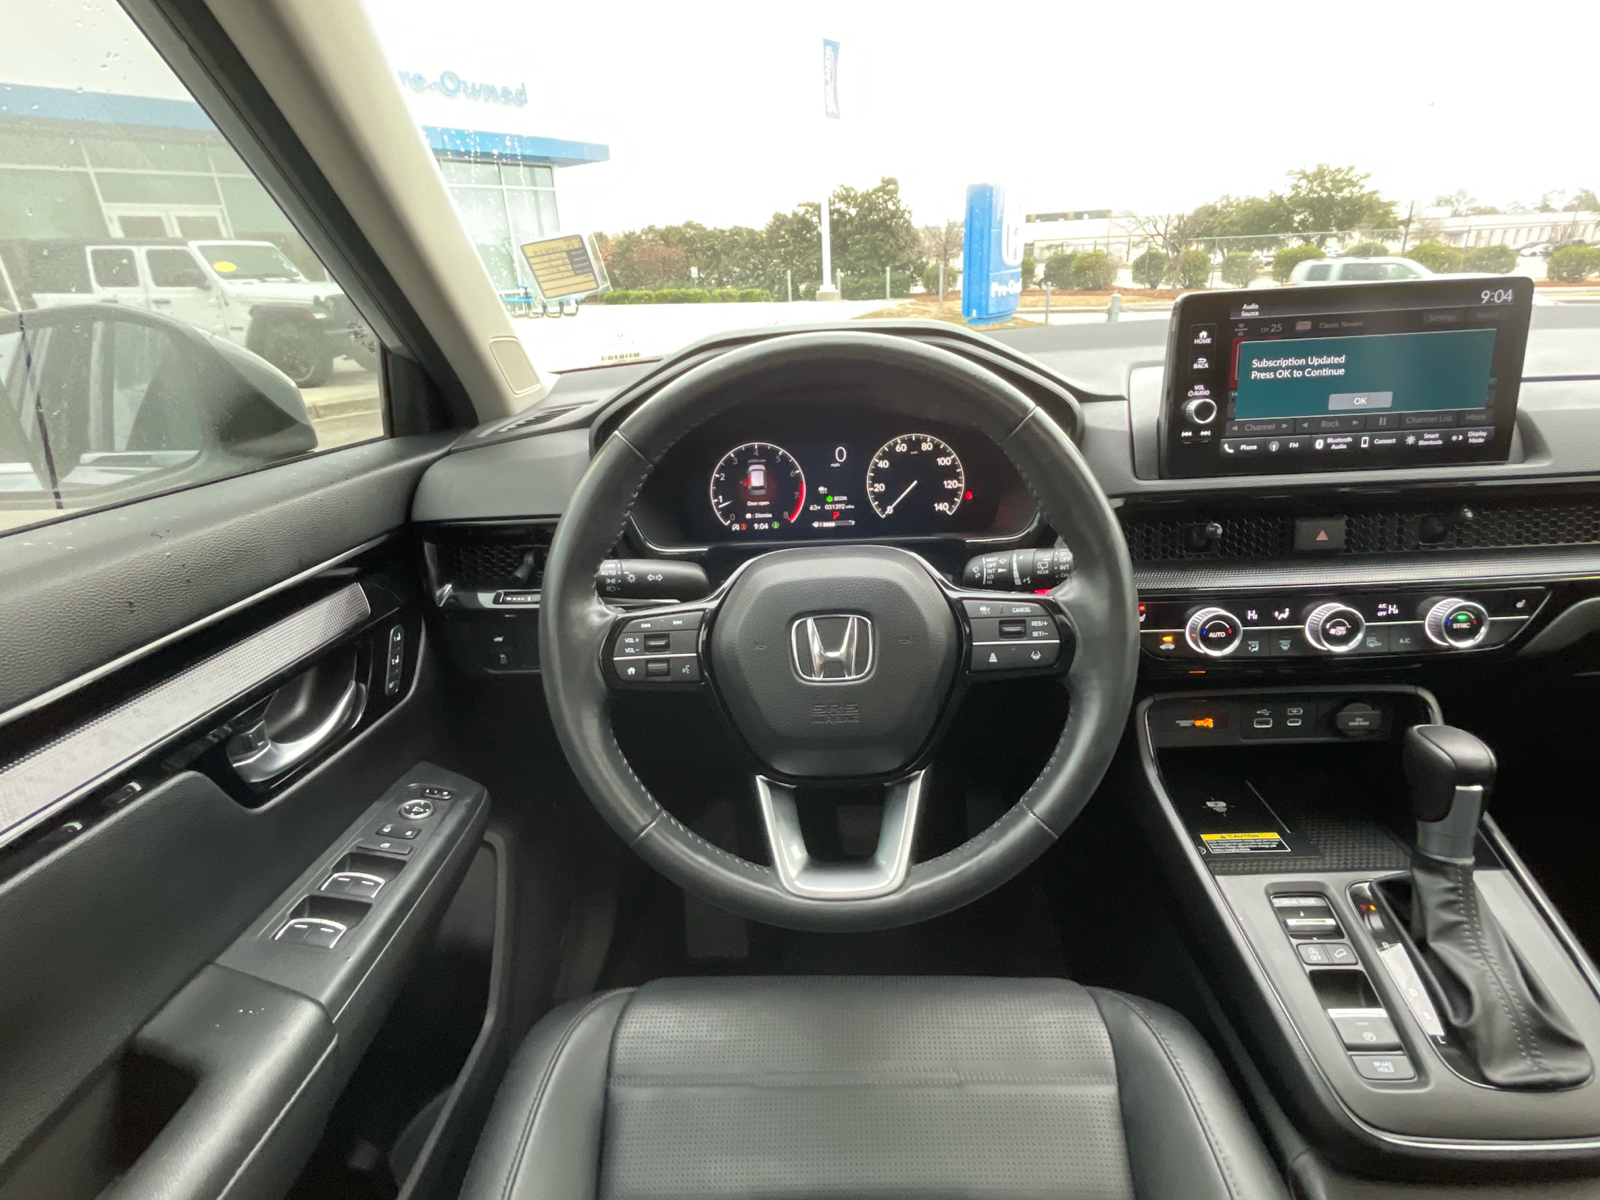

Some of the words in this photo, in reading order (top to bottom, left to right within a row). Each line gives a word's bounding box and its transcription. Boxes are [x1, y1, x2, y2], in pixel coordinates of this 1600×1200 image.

[397, 70, 528, 107] re-Owned
[1481, 289, 1513, 304] 9:04
[1270, 323, 1283, 333] 25
[1319, 321, 1339, 329] Classic
[1252, 357, 1305, 368] Subscription
[1308, 355, 1346, 366] Updated
[1251, 370, 1275, 379] Press
[1276, 368, 1291, 378] OK
[1293, 368, 1302, 377] to
[1304, 367, 1345, 377] Continue
[1353, 397, 1367, 405] OK
[1405, 415, 1437, 424] Channel
[1439, 414, 1453, 422] List
[1465, 413, 1487, 421] More
[1244, 422, 1276, 432] Channel
[1321, 420, 1340, 428] Rock
[1326, 436, 1353, 444] Bluetooth
[895, 443, 907, 452] 60
[921, 442, 933, 451] 80
[877, 459, 889, 468] 40
[936, 457, 951, 466] 100
[720, 473, 726, 481] 2
[873, 483, 885, 492] 20
[943, 480, 958, 488] 120
[933, 503, 949, 511] 140
[832, 511, 840, 519] P
[812, 704, 859, 713] SRS
